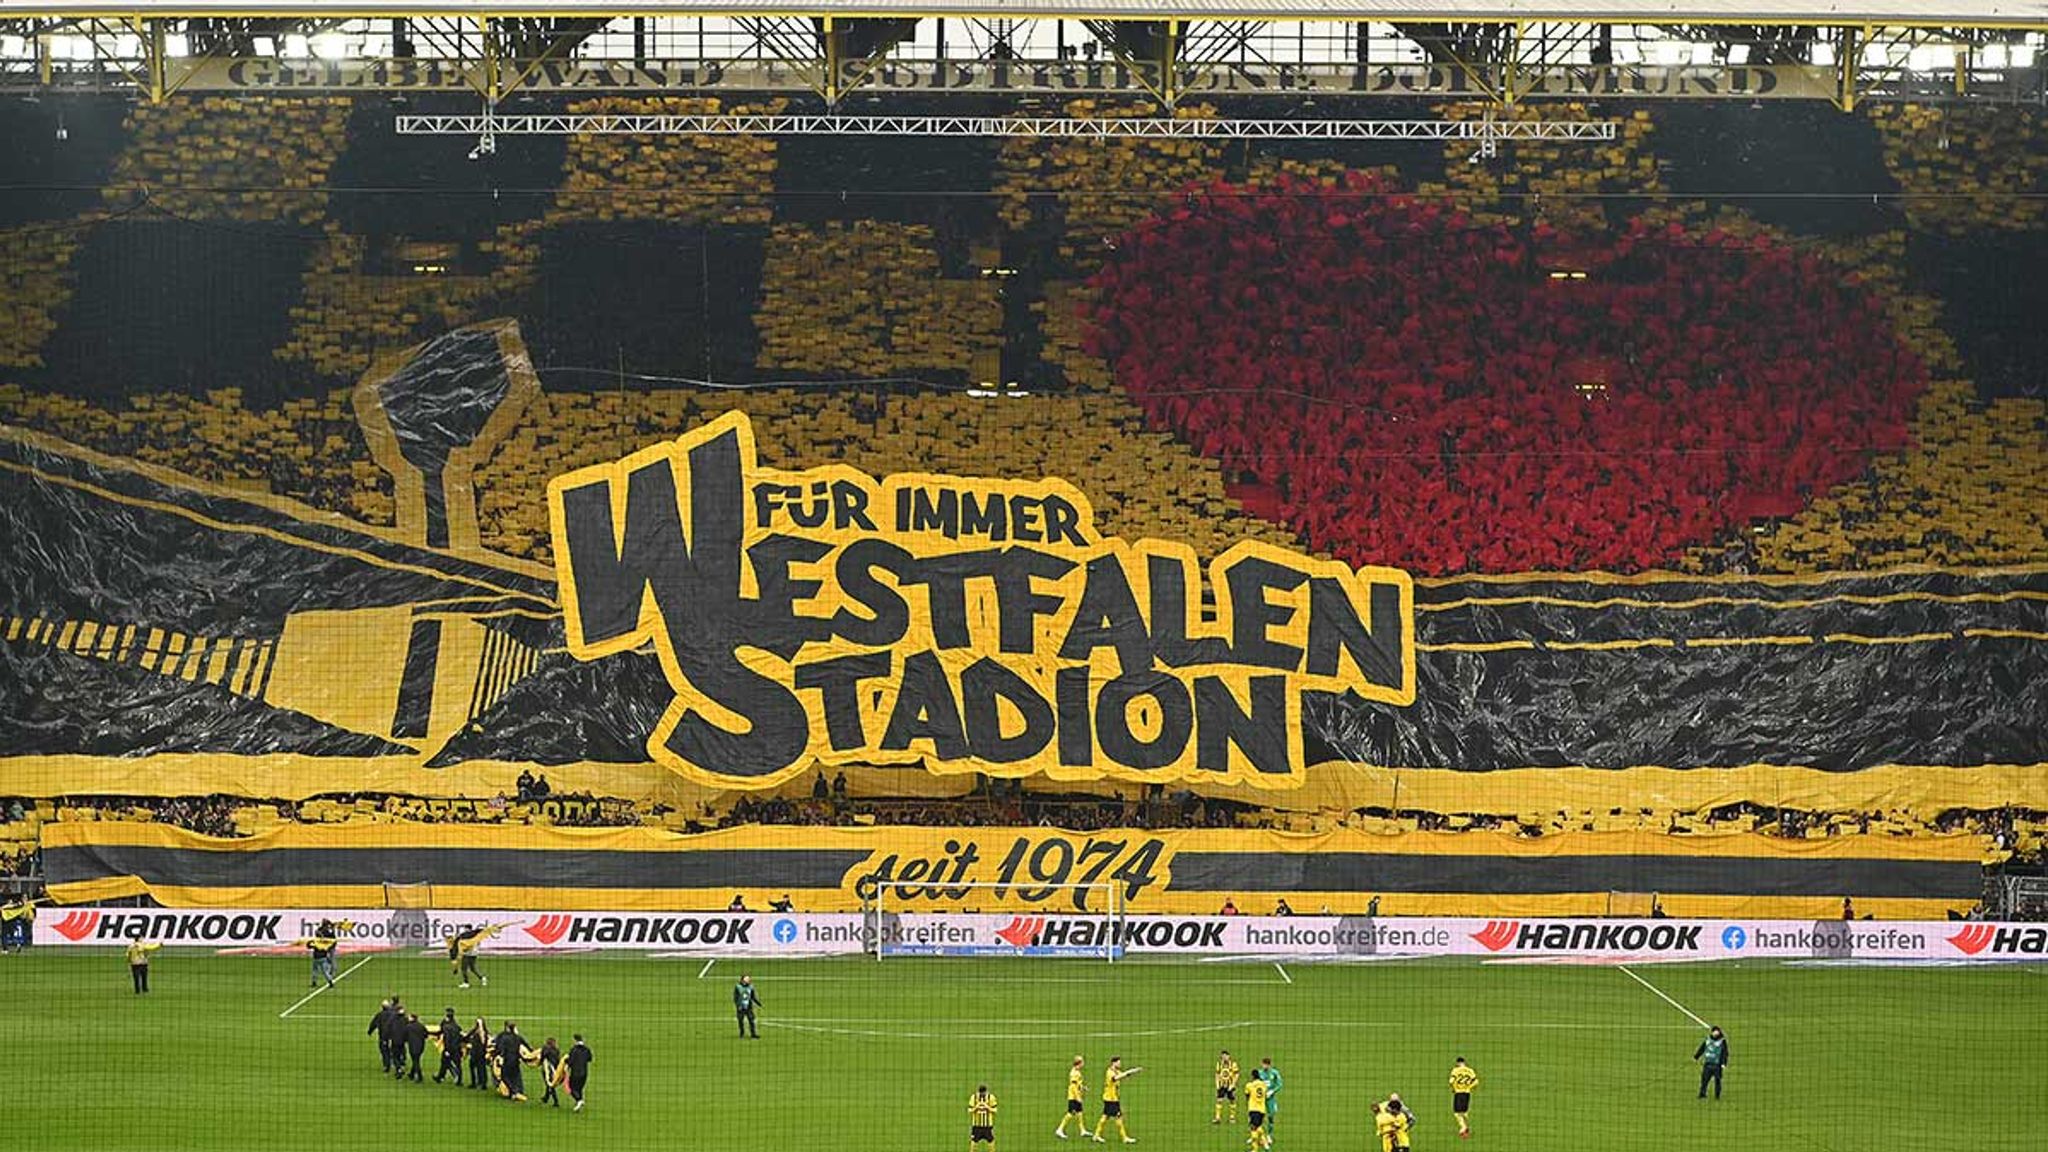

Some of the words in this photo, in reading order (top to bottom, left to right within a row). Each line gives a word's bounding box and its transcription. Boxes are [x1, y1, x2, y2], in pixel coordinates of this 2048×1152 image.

[228, 59, 466, 87] GELBE
[513, 61, 724, 88] WAND
[755, 482, 872, 532] FÜR
[897, 487, 1088, 547] IMMER
[561, 427, 1404, 692] WESTFALEN
[664, 632, 1306, 778] STADION
[855, 840, 979, 901] seit
[995, 838, 1166, 912] 1974
[806, 922, 975, 943] hankookreifen
[1246, 924, 1450, 946] hankookreifen.de
[1755, 928, 1925, 950] hankookreifen
